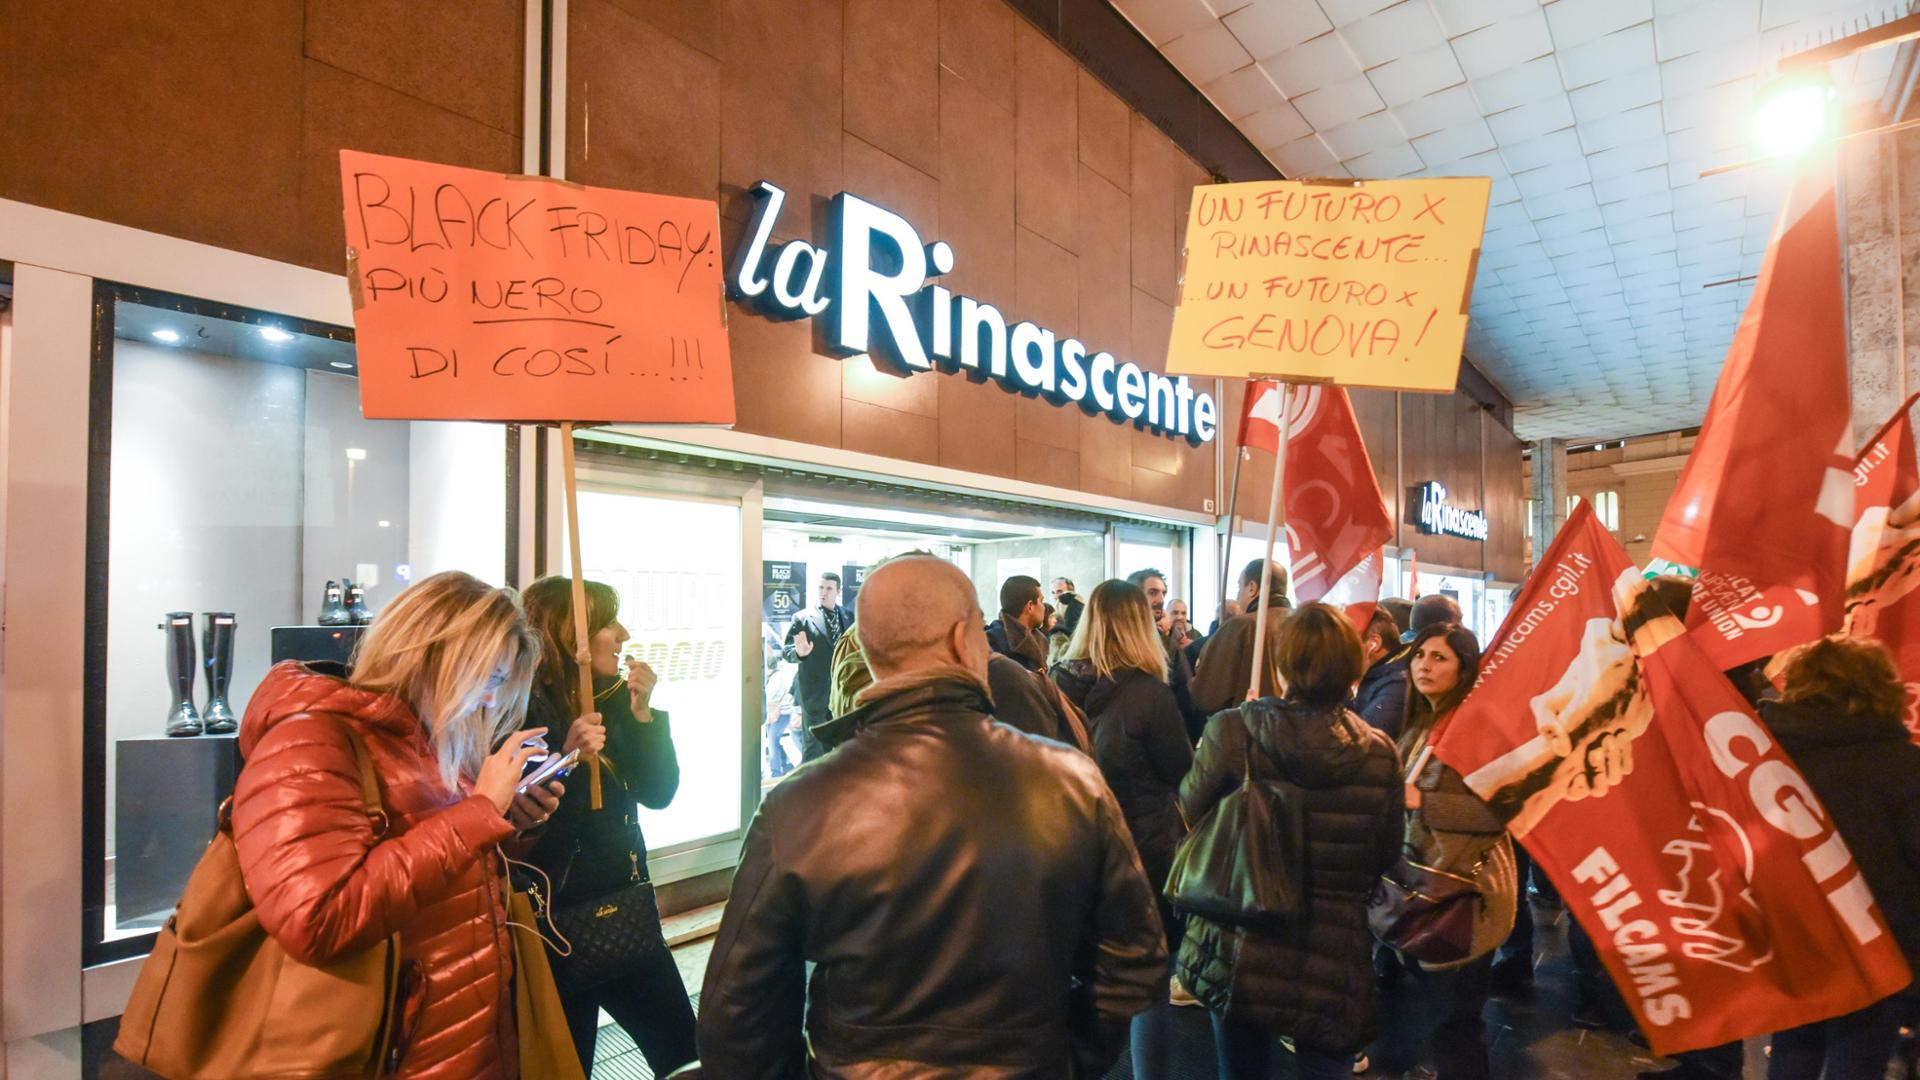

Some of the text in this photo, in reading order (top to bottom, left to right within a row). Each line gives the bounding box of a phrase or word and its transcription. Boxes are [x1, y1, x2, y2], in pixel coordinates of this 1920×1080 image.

[354, 173, 536, 258] BLACK
[1198, 189, 1446, 226] UN FUTURO X
[366, 268, 603, 314] PIÙ NERO
[738, 181, 1216, 442] la Rinascente
[1263, 275, 1387, 306] FUTURO
[1202, 308, 1438, 363] GENOVA!
[406, 347, 457, 378] DI
[1431, 481, 1488, 541] Rinascente
[774, 594, 790, 609] 50
[1700, 599, 1745, 641] UNION
[1704, 710, 1883, 945] CGIL
[1570, 846, 1692, 1027] FILCAMS
